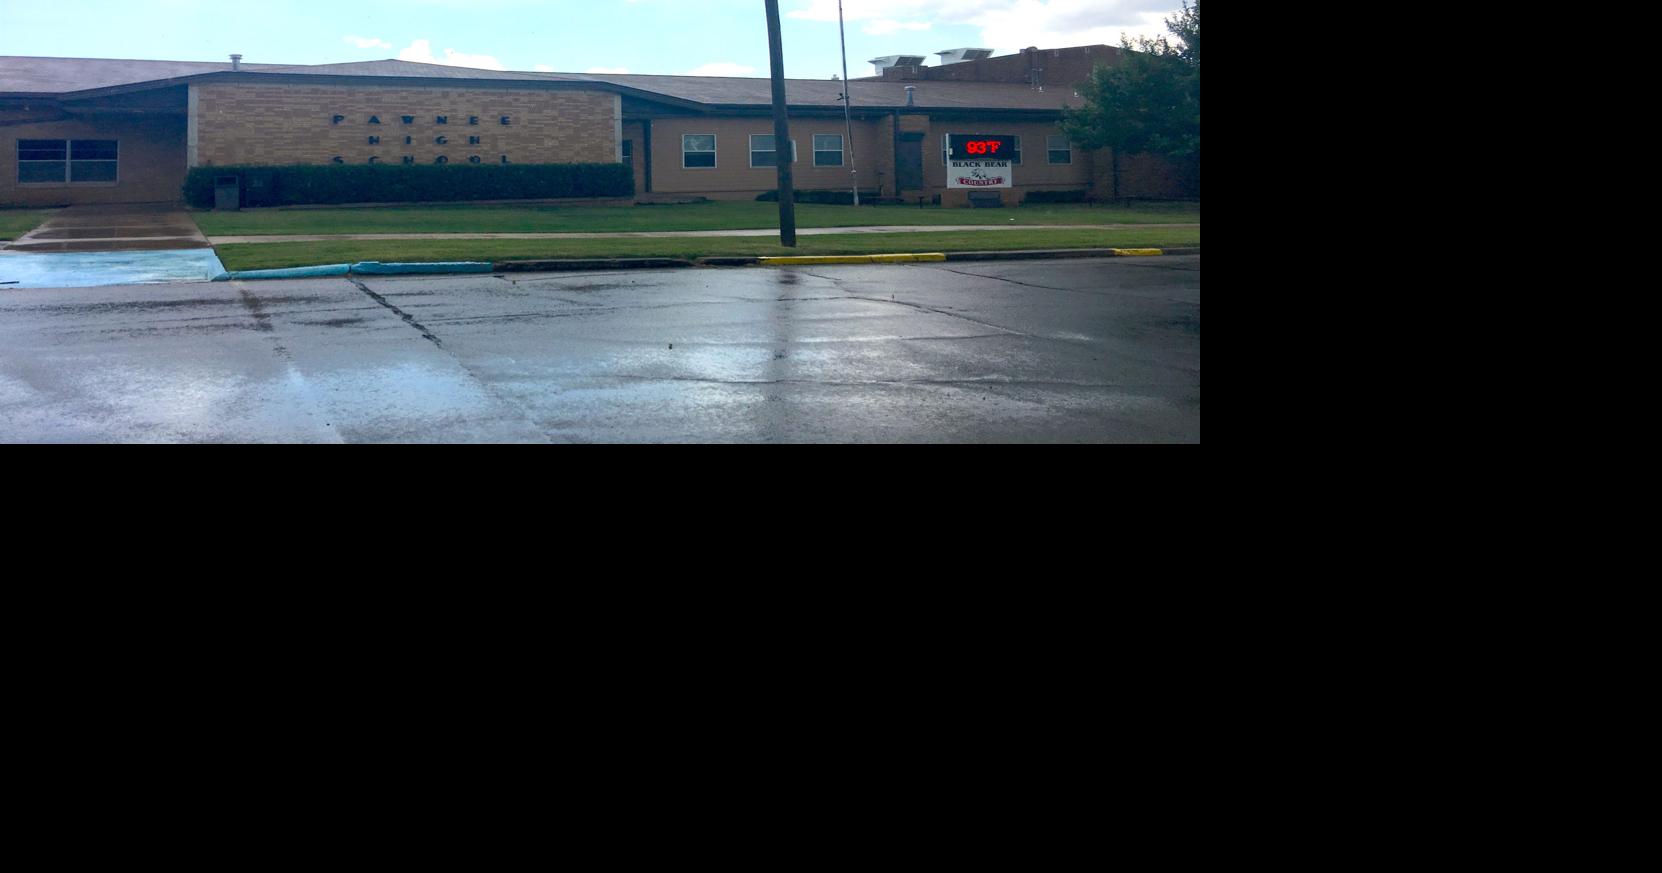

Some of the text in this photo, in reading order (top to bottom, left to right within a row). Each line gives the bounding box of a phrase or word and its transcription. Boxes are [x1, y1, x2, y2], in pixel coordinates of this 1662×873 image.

[333, 115, 510, 125] PAWNEE
[368, 135, 480, 145] HIGH
[333, 155, 510, 164] SCHOOL
[962, 178, 997, 186] COUNTRY
